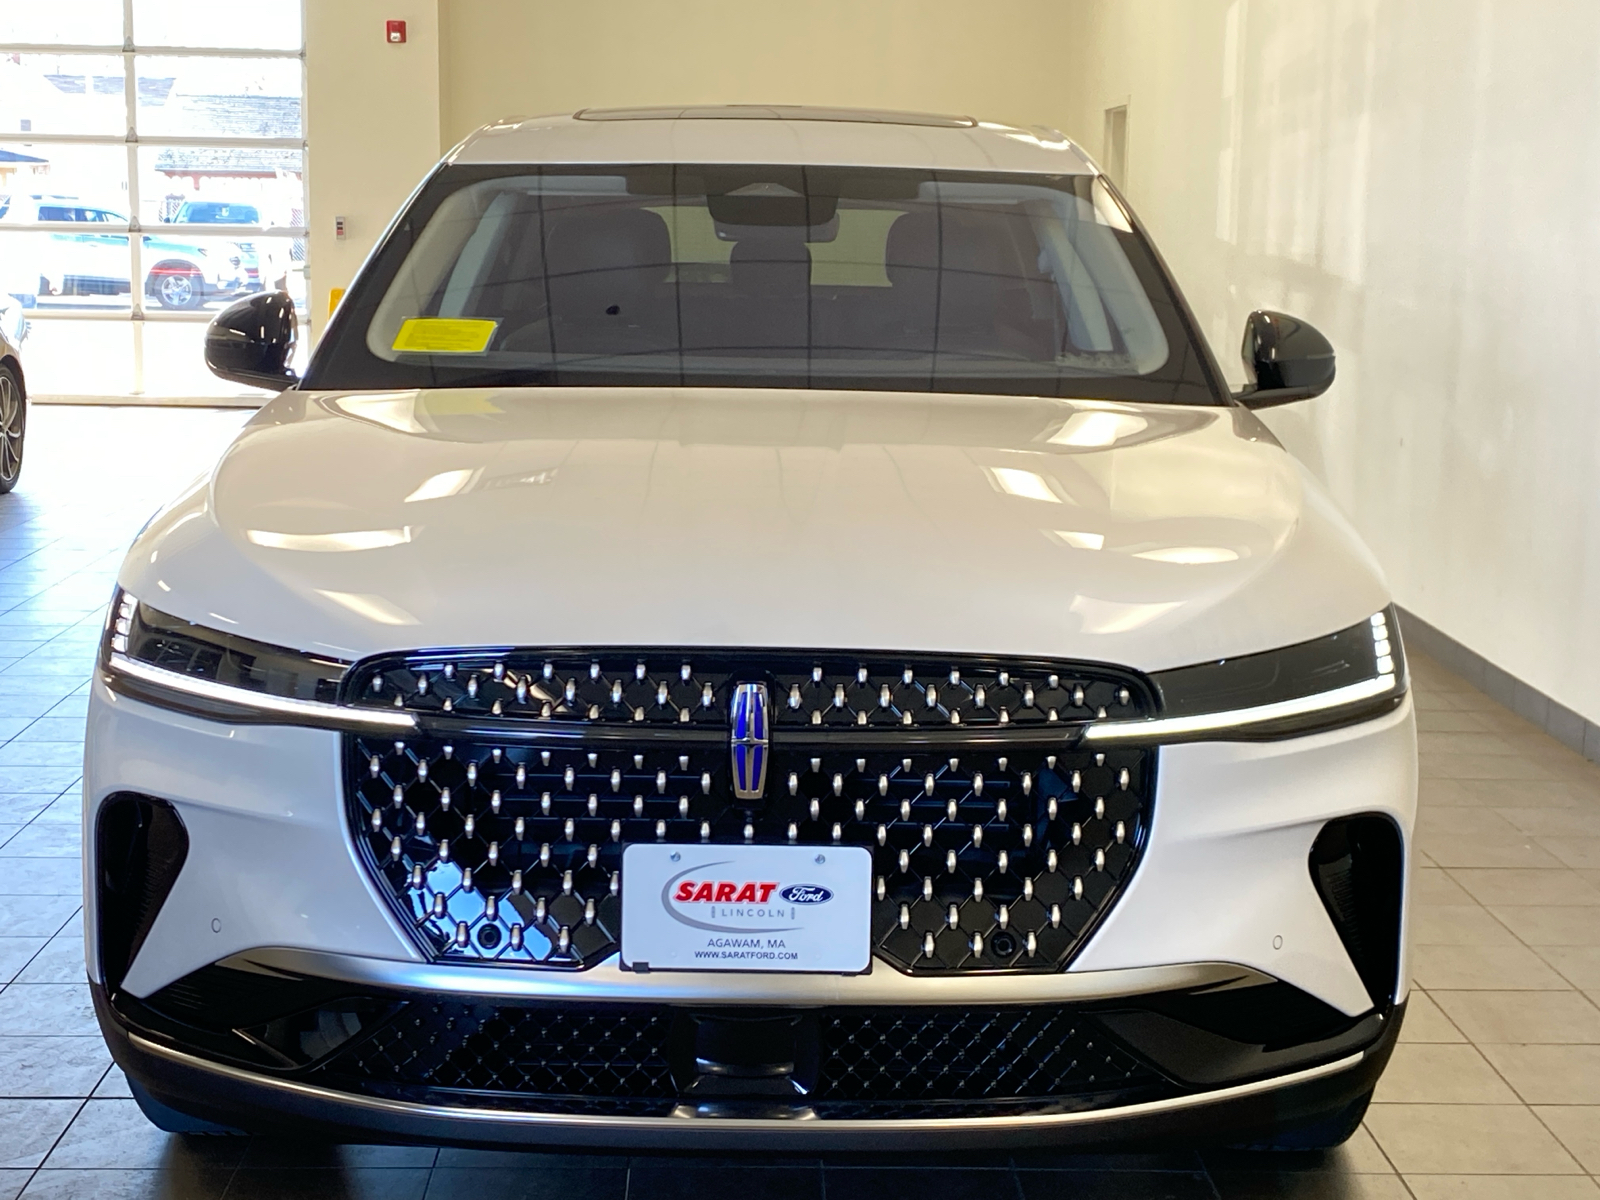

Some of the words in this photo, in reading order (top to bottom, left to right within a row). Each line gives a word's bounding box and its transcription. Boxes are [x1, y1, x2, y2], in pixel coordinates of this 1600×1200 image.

[674, 880, 779, 904] SARAT
[721, 908, 785, 918] LINCOLN
[707, 938, 764, 949] AGAWAM,
[768, 939, 786, 949] MA
[694, 951, 799, 960] WWW.SARATFORD.COM
